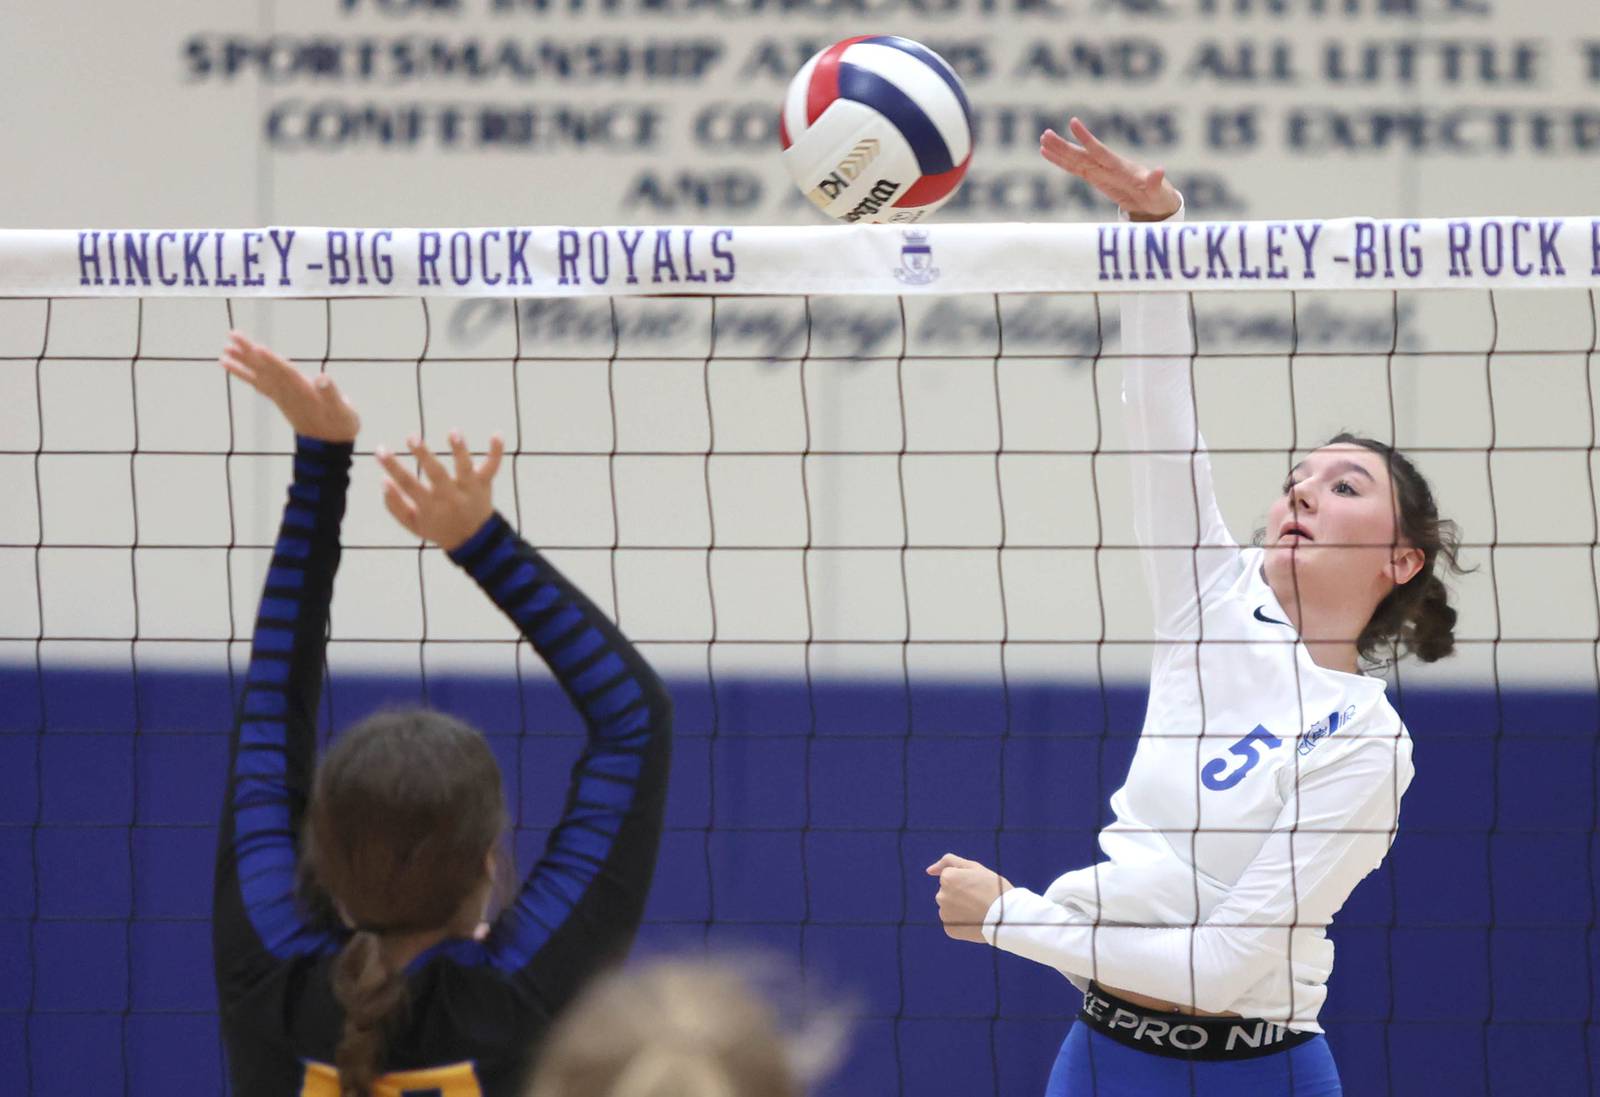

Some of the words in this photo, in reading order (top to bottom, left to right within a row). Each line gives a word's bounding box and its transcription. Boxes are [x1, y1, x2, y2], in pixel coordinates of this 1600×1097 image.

[184, 38, 716, 82] SPORTSMANSHIP
[1010, 38, 1166, 84] AND
[1190, 38, 1298, 84] ALL
[1318, 38, 1540, 84] LITTLE
[265, 104, 660, 150] CONFERENCE
[1287, 106, 1600, 152] EXPECTED
[624, 170, 762, 212] AND
[78, 230, 394, 287] HINCKLEY-BIG
[418, 230, 533, 286] ROCK
[557, 230, 736, 285] ROYALS
[1098, 221, 1423, 281] HINCKLEY-BIG
[1448, 221, 1567, 278] ROCK
[1201, 723, 1283, 791] 5
[1108, 1008, 1209, 1050] PRO
